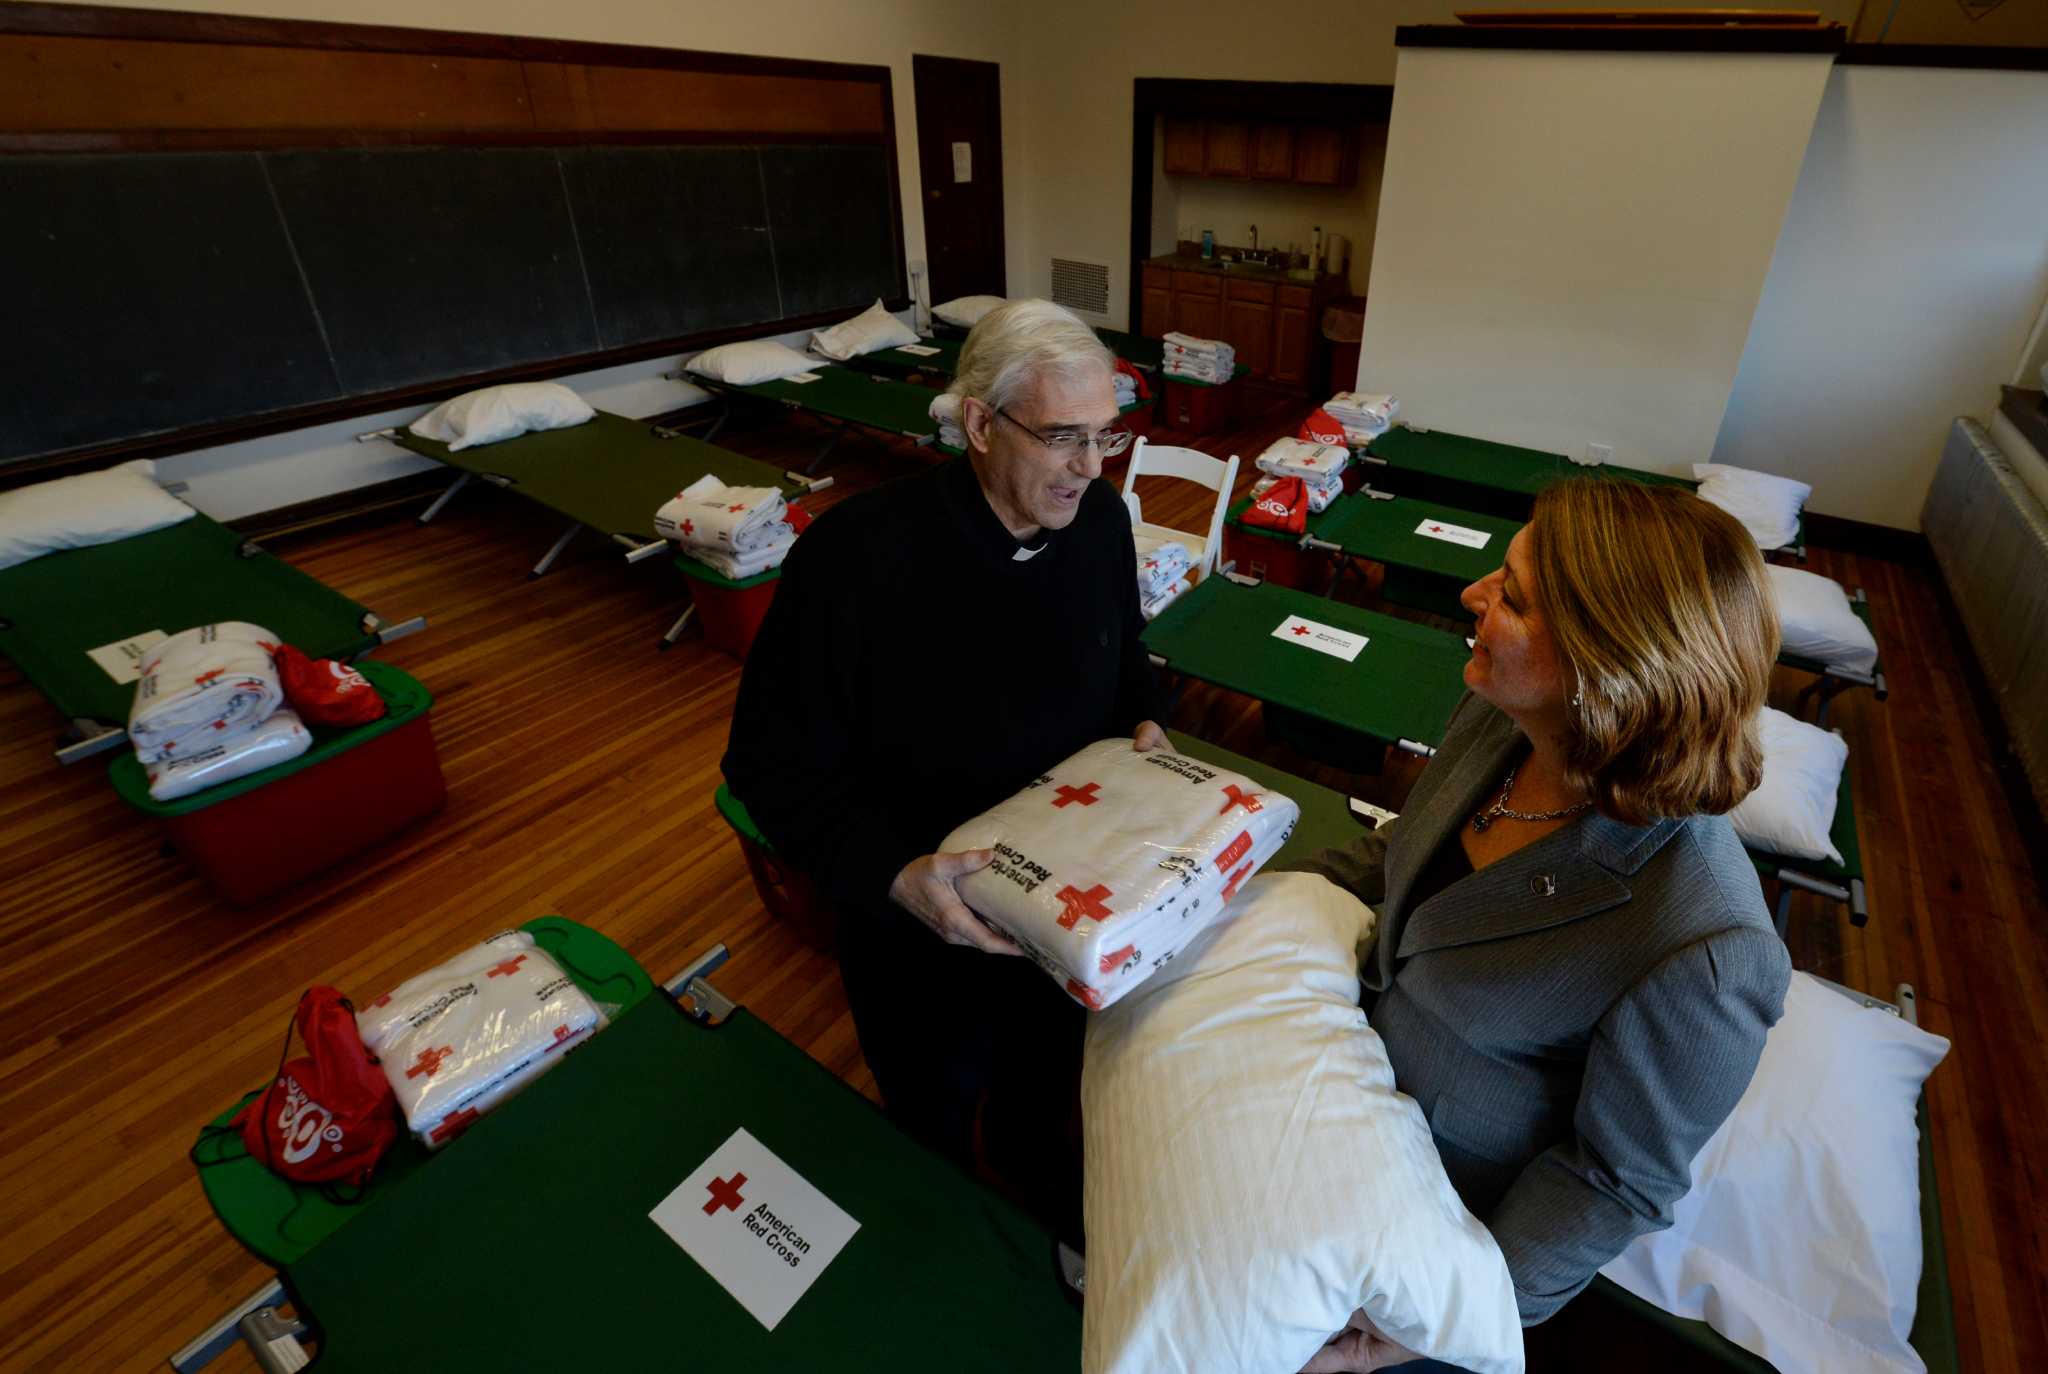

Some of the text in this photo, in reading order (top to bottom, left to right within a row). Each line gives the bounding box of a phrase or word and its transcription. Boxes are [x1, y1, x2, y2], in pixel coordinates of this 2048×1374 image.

[1145, 756, 1206, 785] American
[1189, 765, 1217, 779] Red
[991, 859, 1039, 894] Americ
[993, 842, 1053, 882] Red Cross
[742, 1213, 801, 1268] Red Cross
[753, 1202, 811, 1254] American
